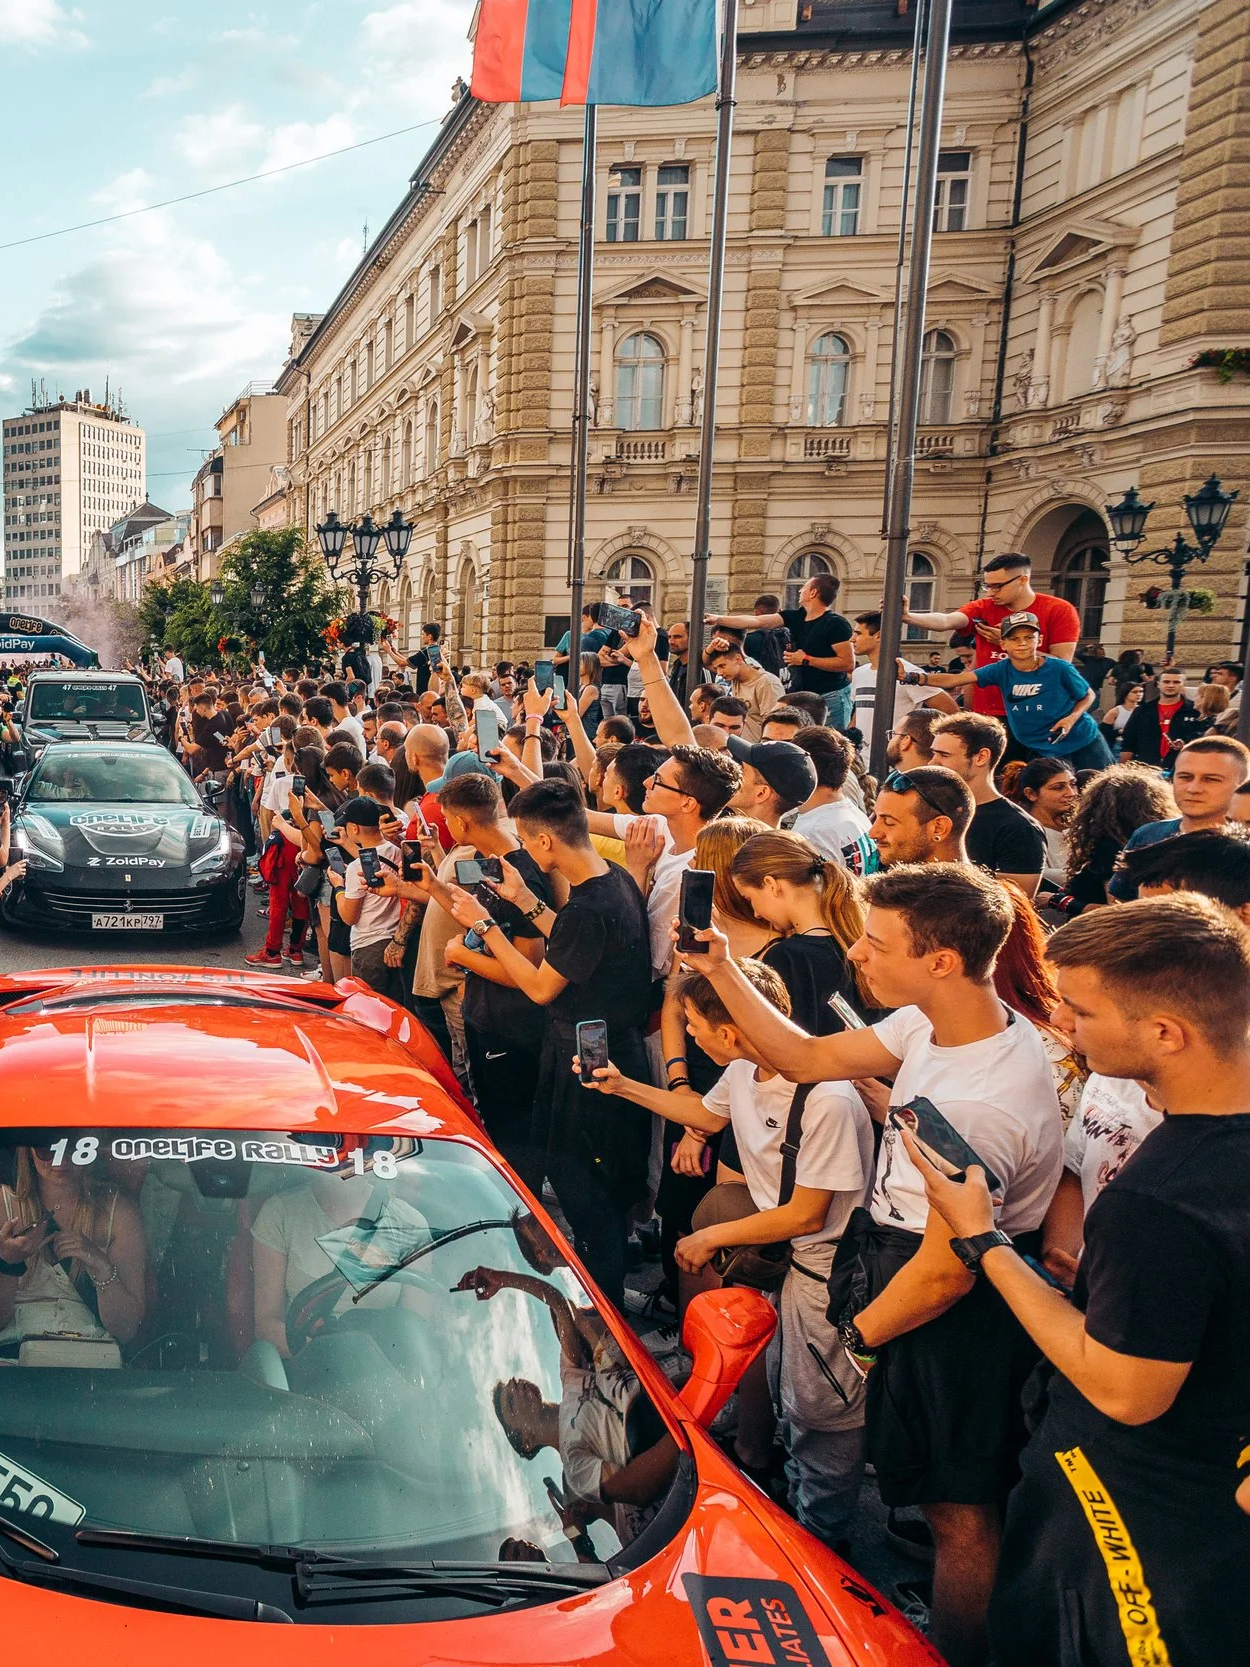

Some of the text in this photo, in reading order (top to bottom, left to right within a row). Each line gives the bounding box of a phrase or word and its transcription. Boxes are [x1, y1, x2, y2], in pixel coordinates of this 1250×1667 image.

[1012, 683, 1043, 697] NIKE
[105, 857, 166, 868] ZoidPay
[143, 915, 160, 924] 797
[49, 1137, 99, 1166] 18
[348, 1147, 398, 1179] 18
[706, 1596, 777, 1667] ER
[760, 1597, 813, 1667] IATES
